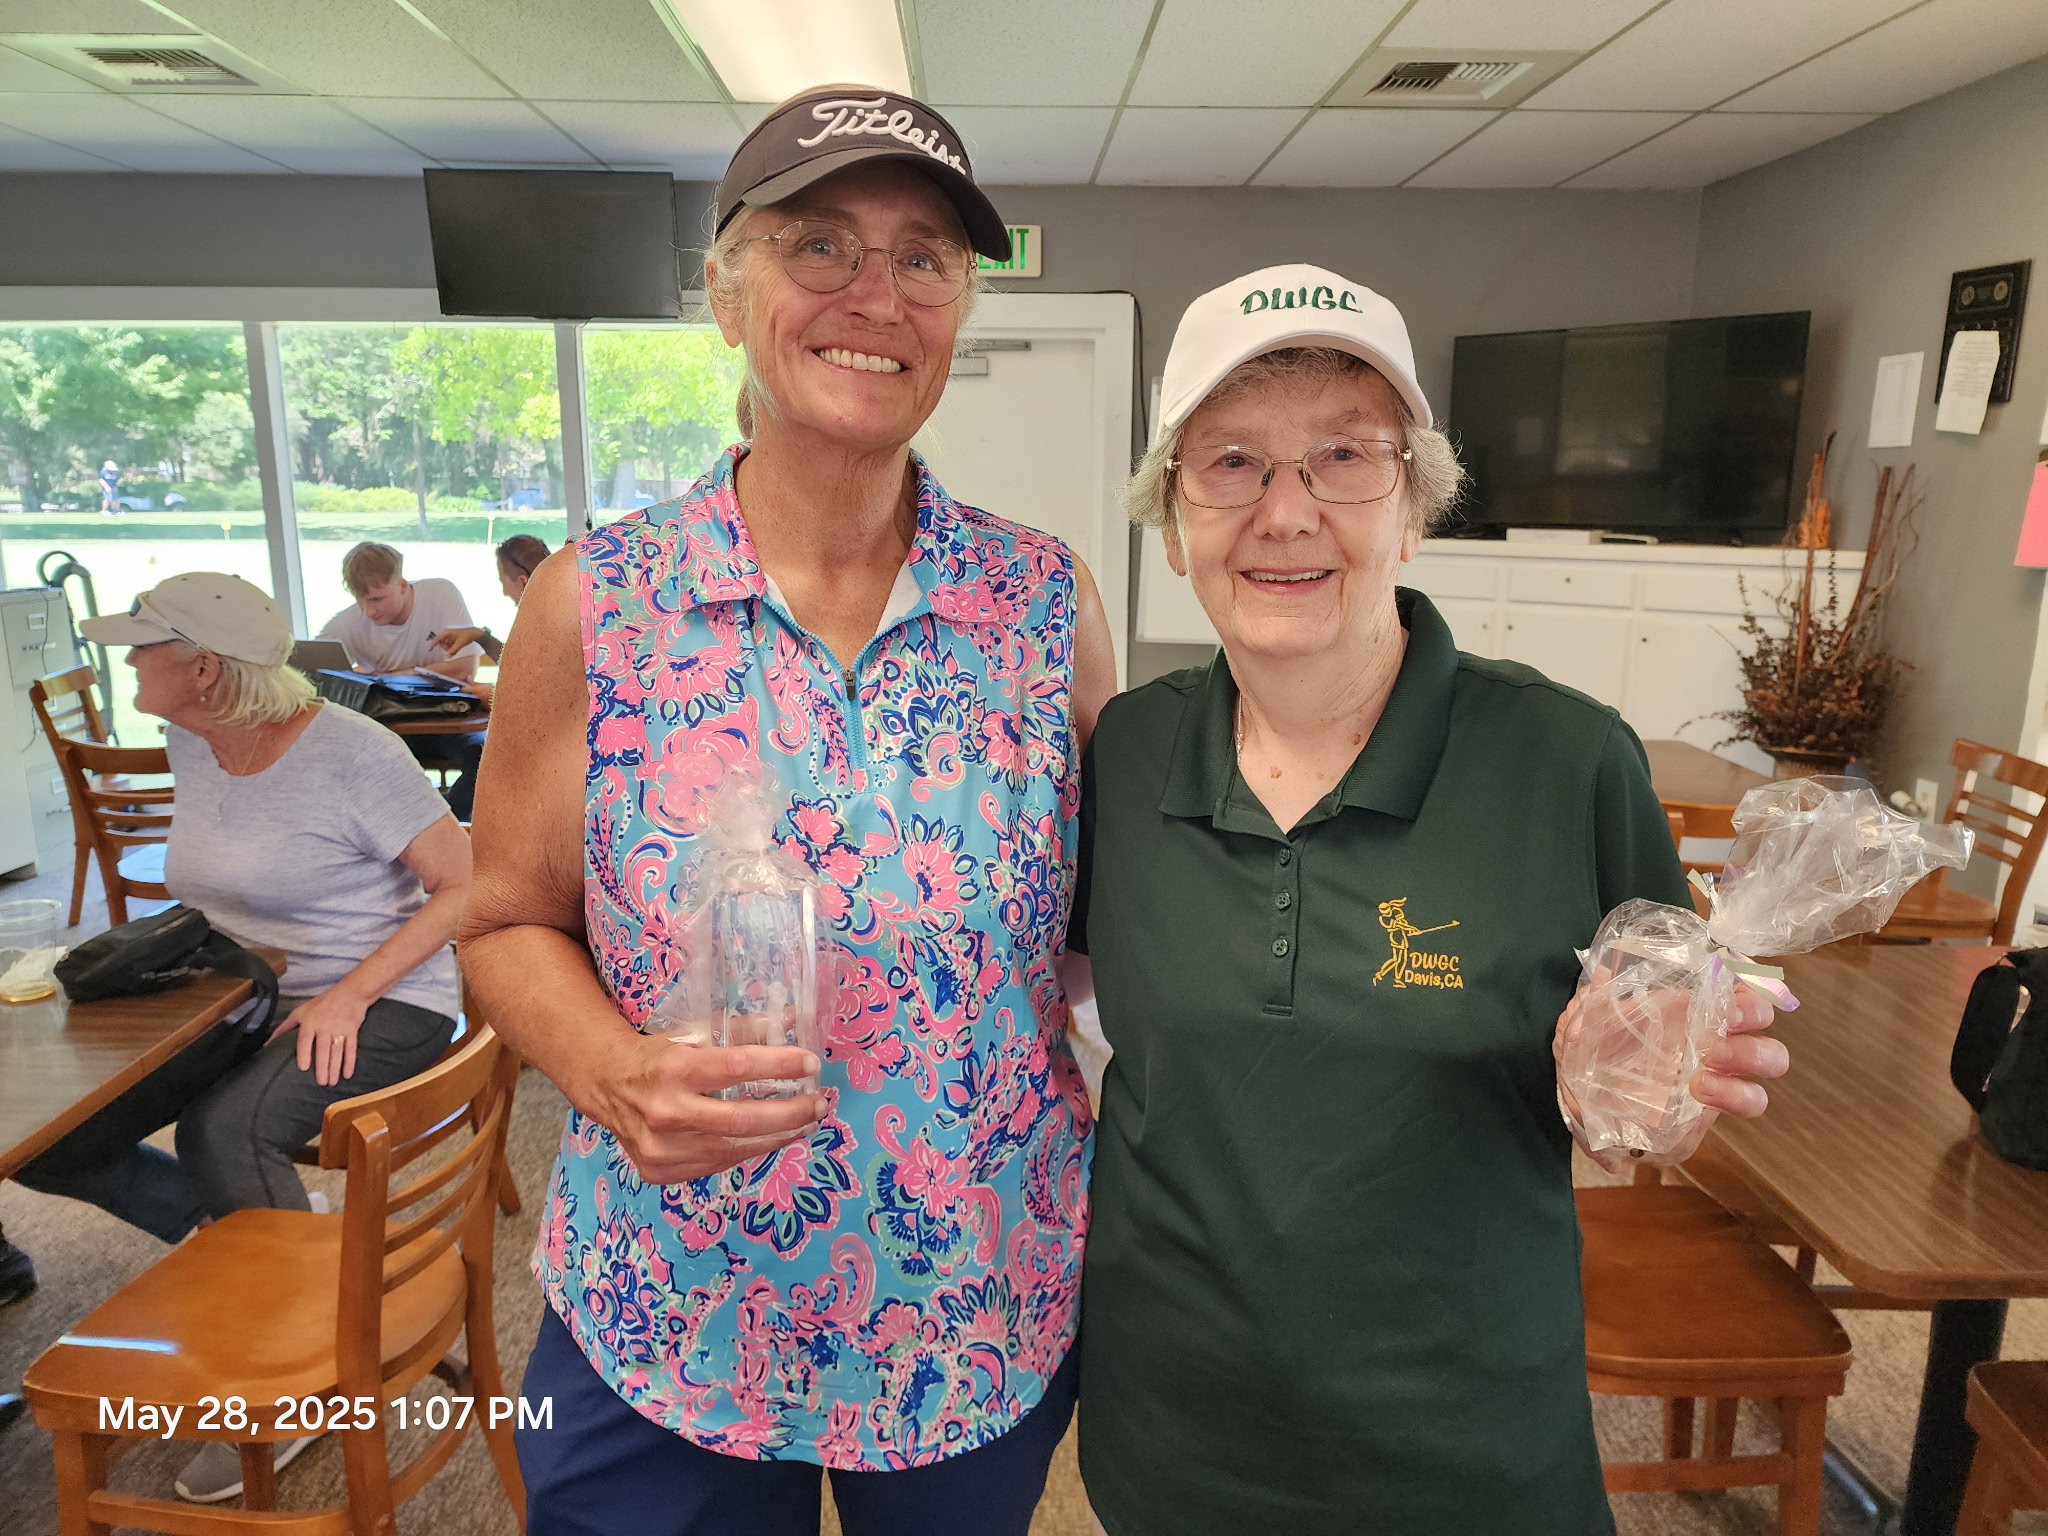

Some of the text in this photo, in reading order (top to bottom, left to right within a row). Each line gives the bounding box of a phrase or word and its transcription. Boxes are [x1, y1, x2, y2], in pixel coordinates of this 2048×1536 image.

[978, 228, 1030, 270] IT
[1240, 286, 1364, 316] DWGC
[1409, 951, 1460, 972] DWGC
[1404, 969, 1464, 990] Davis,CA
